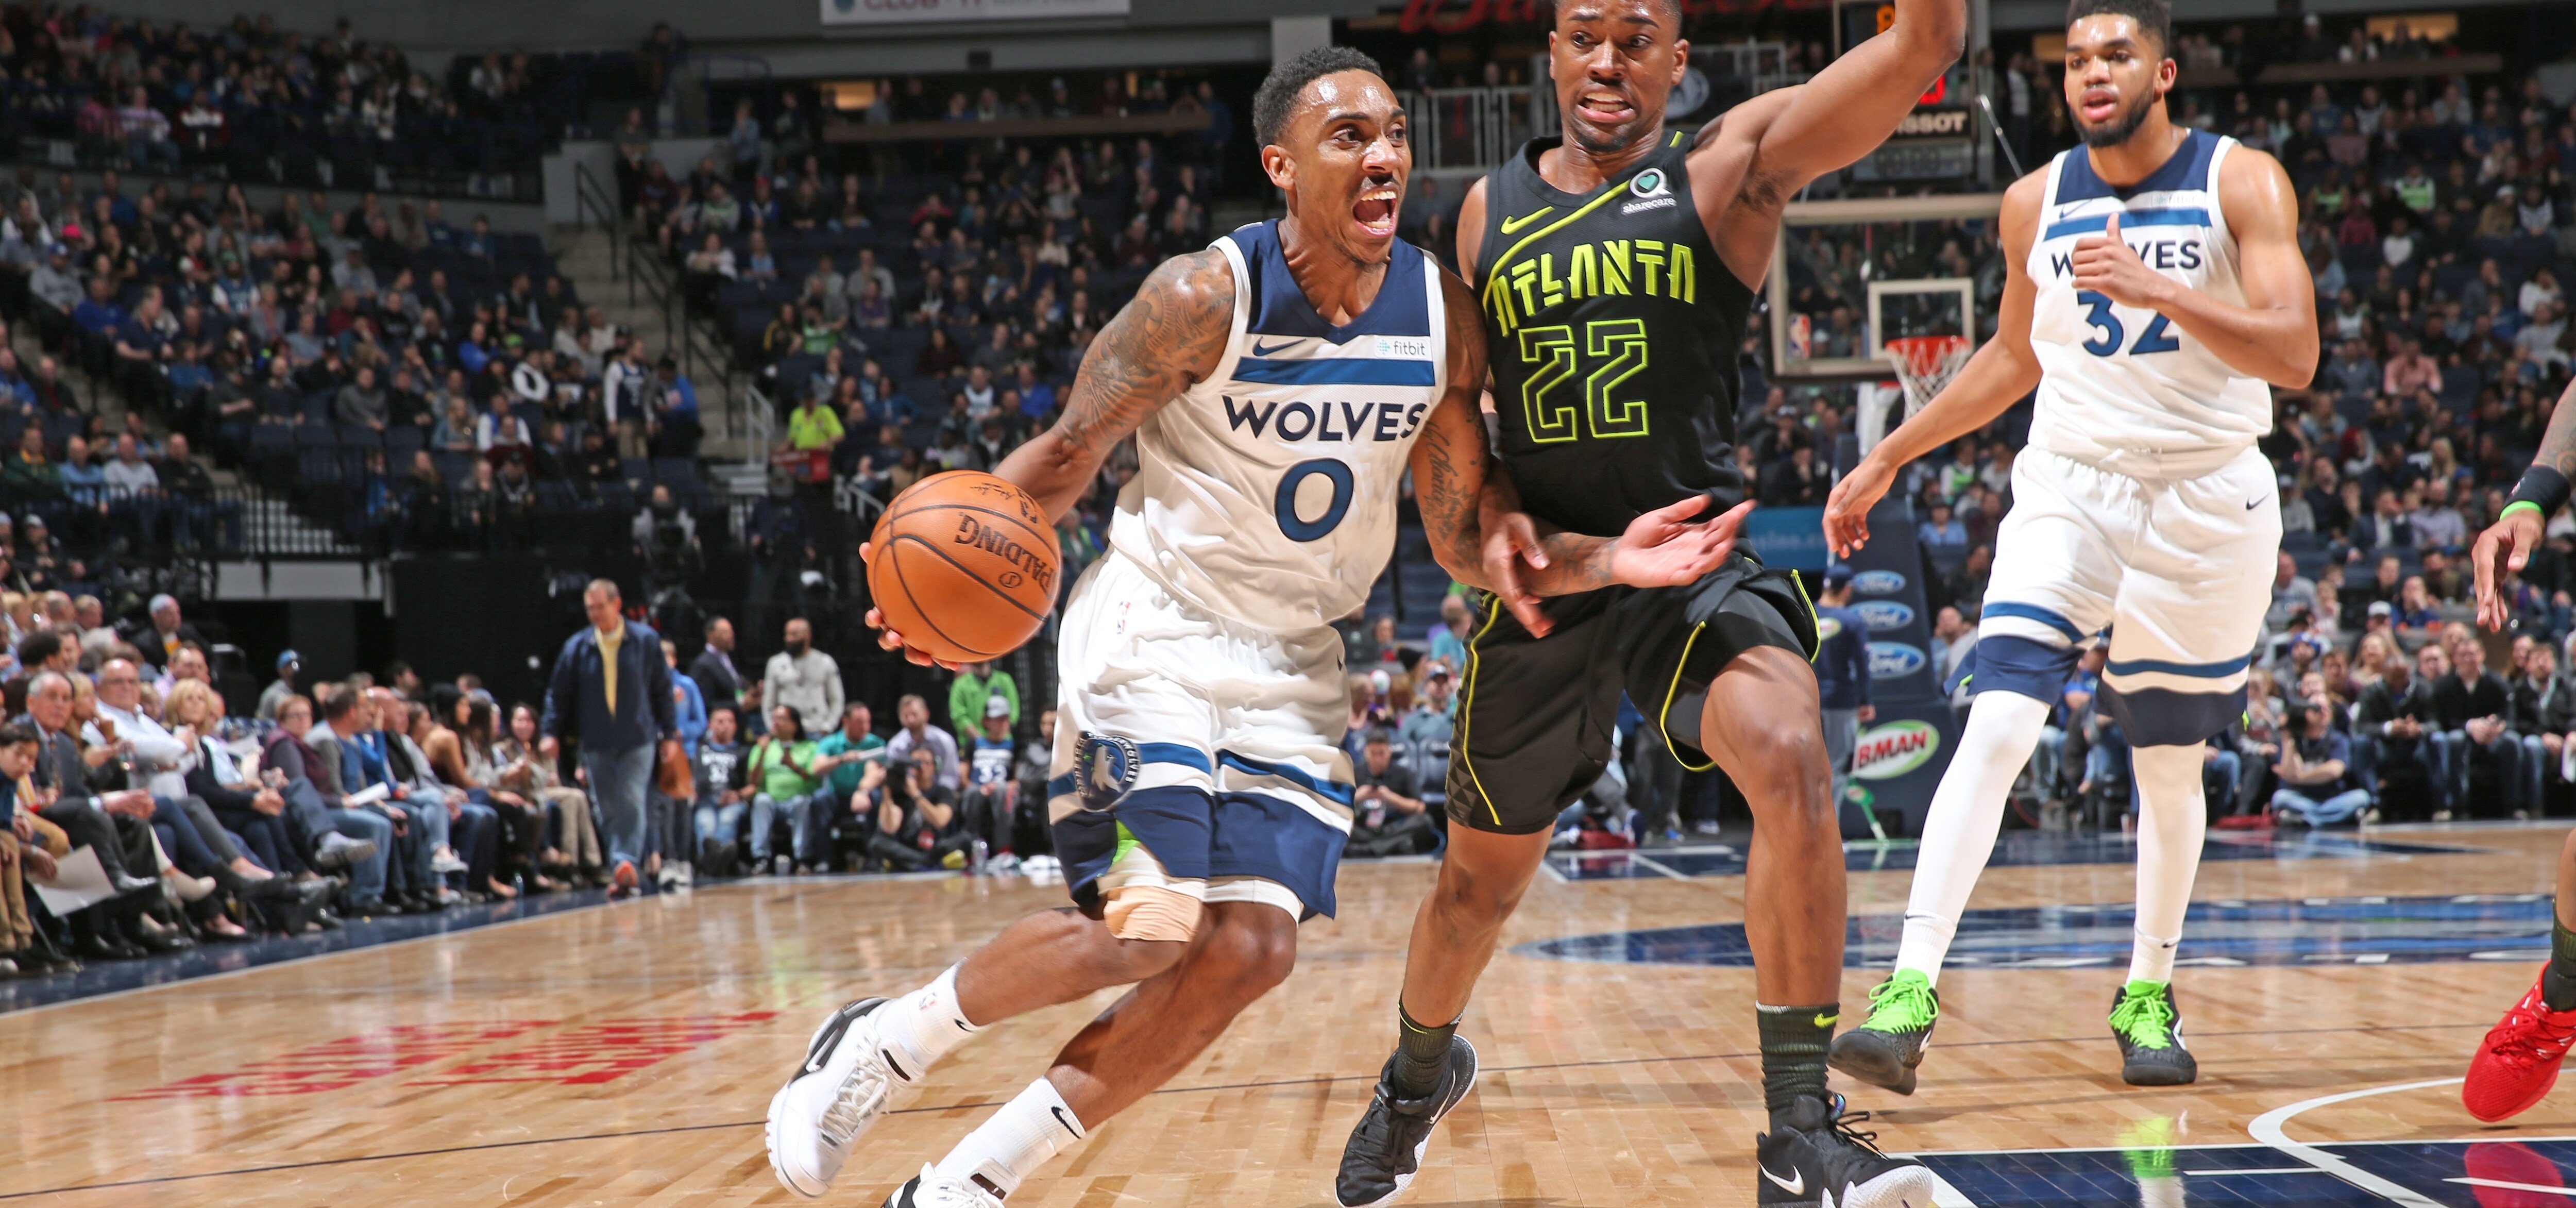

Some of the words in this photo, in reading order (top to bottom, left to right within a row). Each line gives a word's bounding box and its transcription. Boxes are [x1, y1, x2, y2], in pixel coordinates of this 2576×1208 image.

[1897, 112, 1968, 134] SSOT
[1623, 197, 1677, 214] sharecare
[2052, 240, 2201, 279] WVES
[1492, 240, 1695, 337] ATLANTA
[1394, 340, 1426, 356] fitbit
[2077, 292, 2180, 357] 32
[1518, 318, 1650, 443] 22
[1221, 395, 1427, 442] WOLVES
[1275, 458, 1354, 542] 0
[955, 514, 1059, 600] PALDING
[1858, 731, 1927, 768] BMAN
